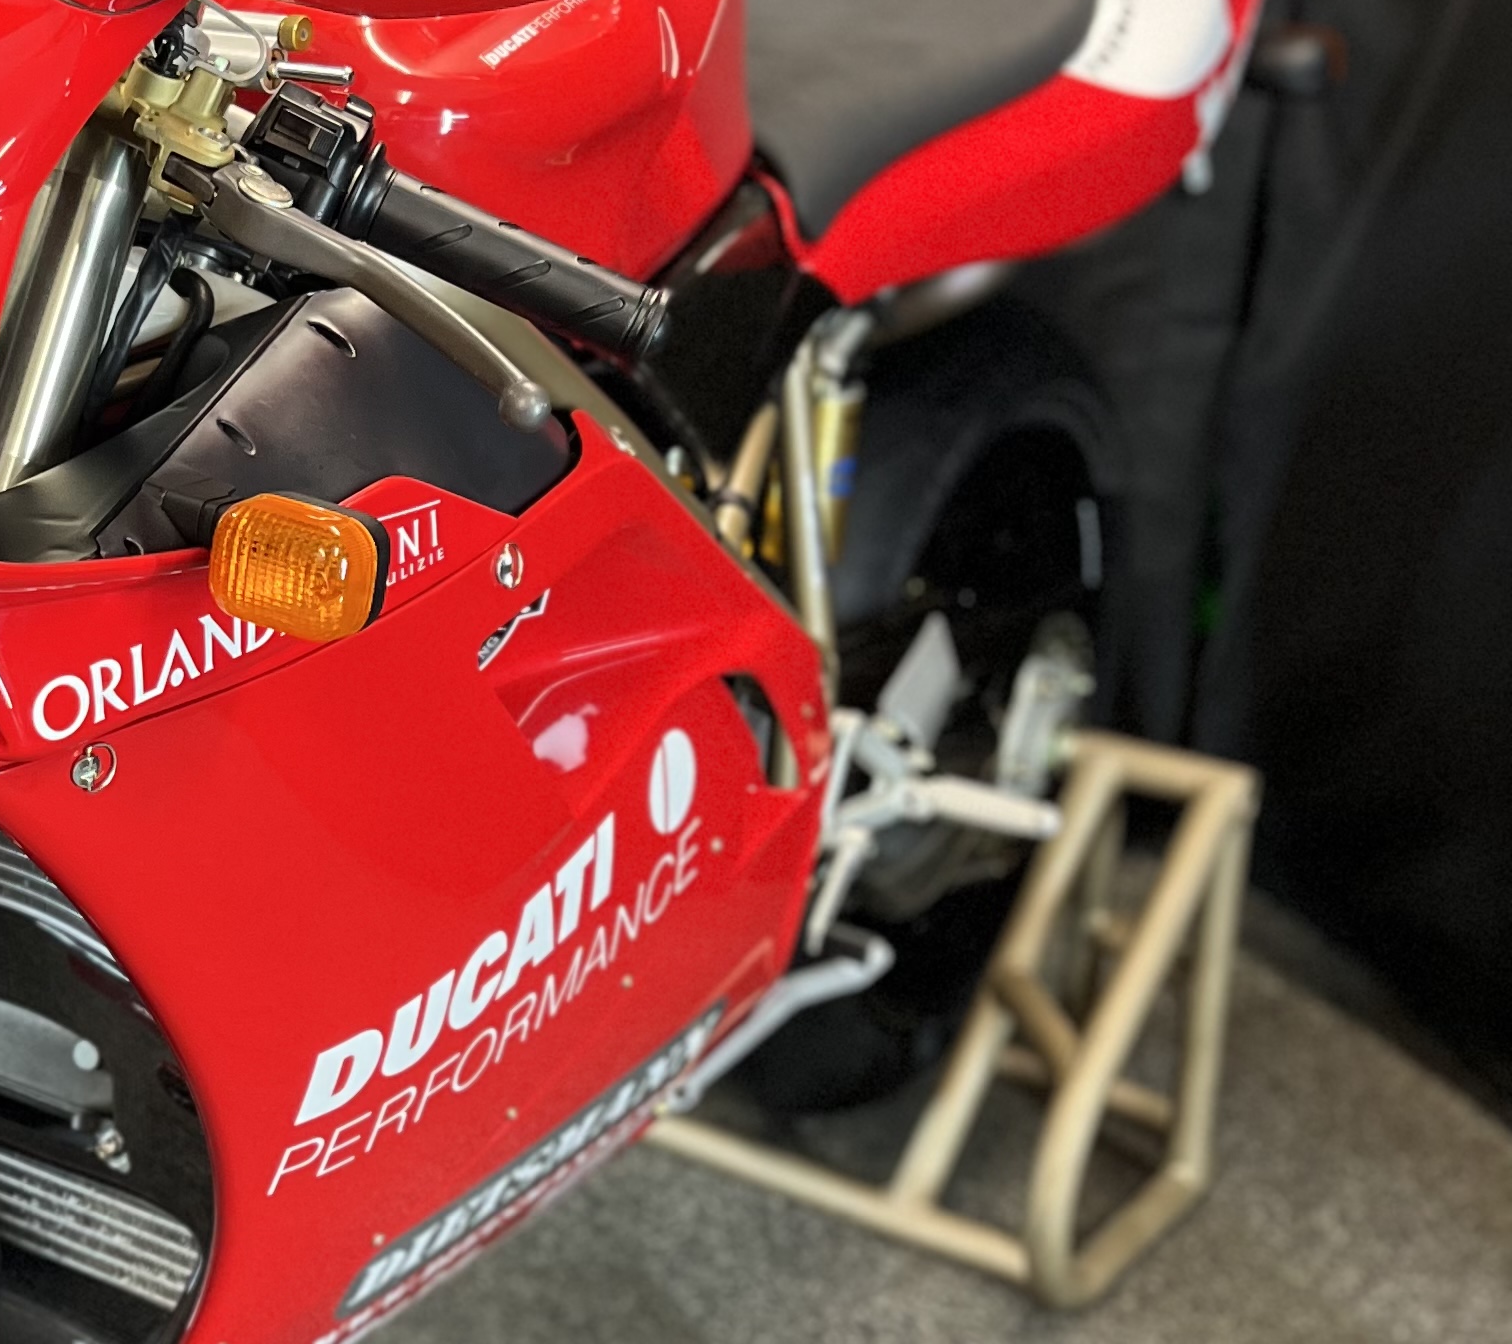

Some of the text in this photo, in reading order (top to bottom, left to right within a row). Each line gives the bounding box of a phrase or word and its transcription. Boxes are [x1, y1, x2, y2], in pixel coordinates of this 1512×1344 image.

[386, 546, 445, 587] ULIZIE
[267, 817, 702, 1197] PERFORMANCE
[294, 810, 616, 1126] DUCATI
